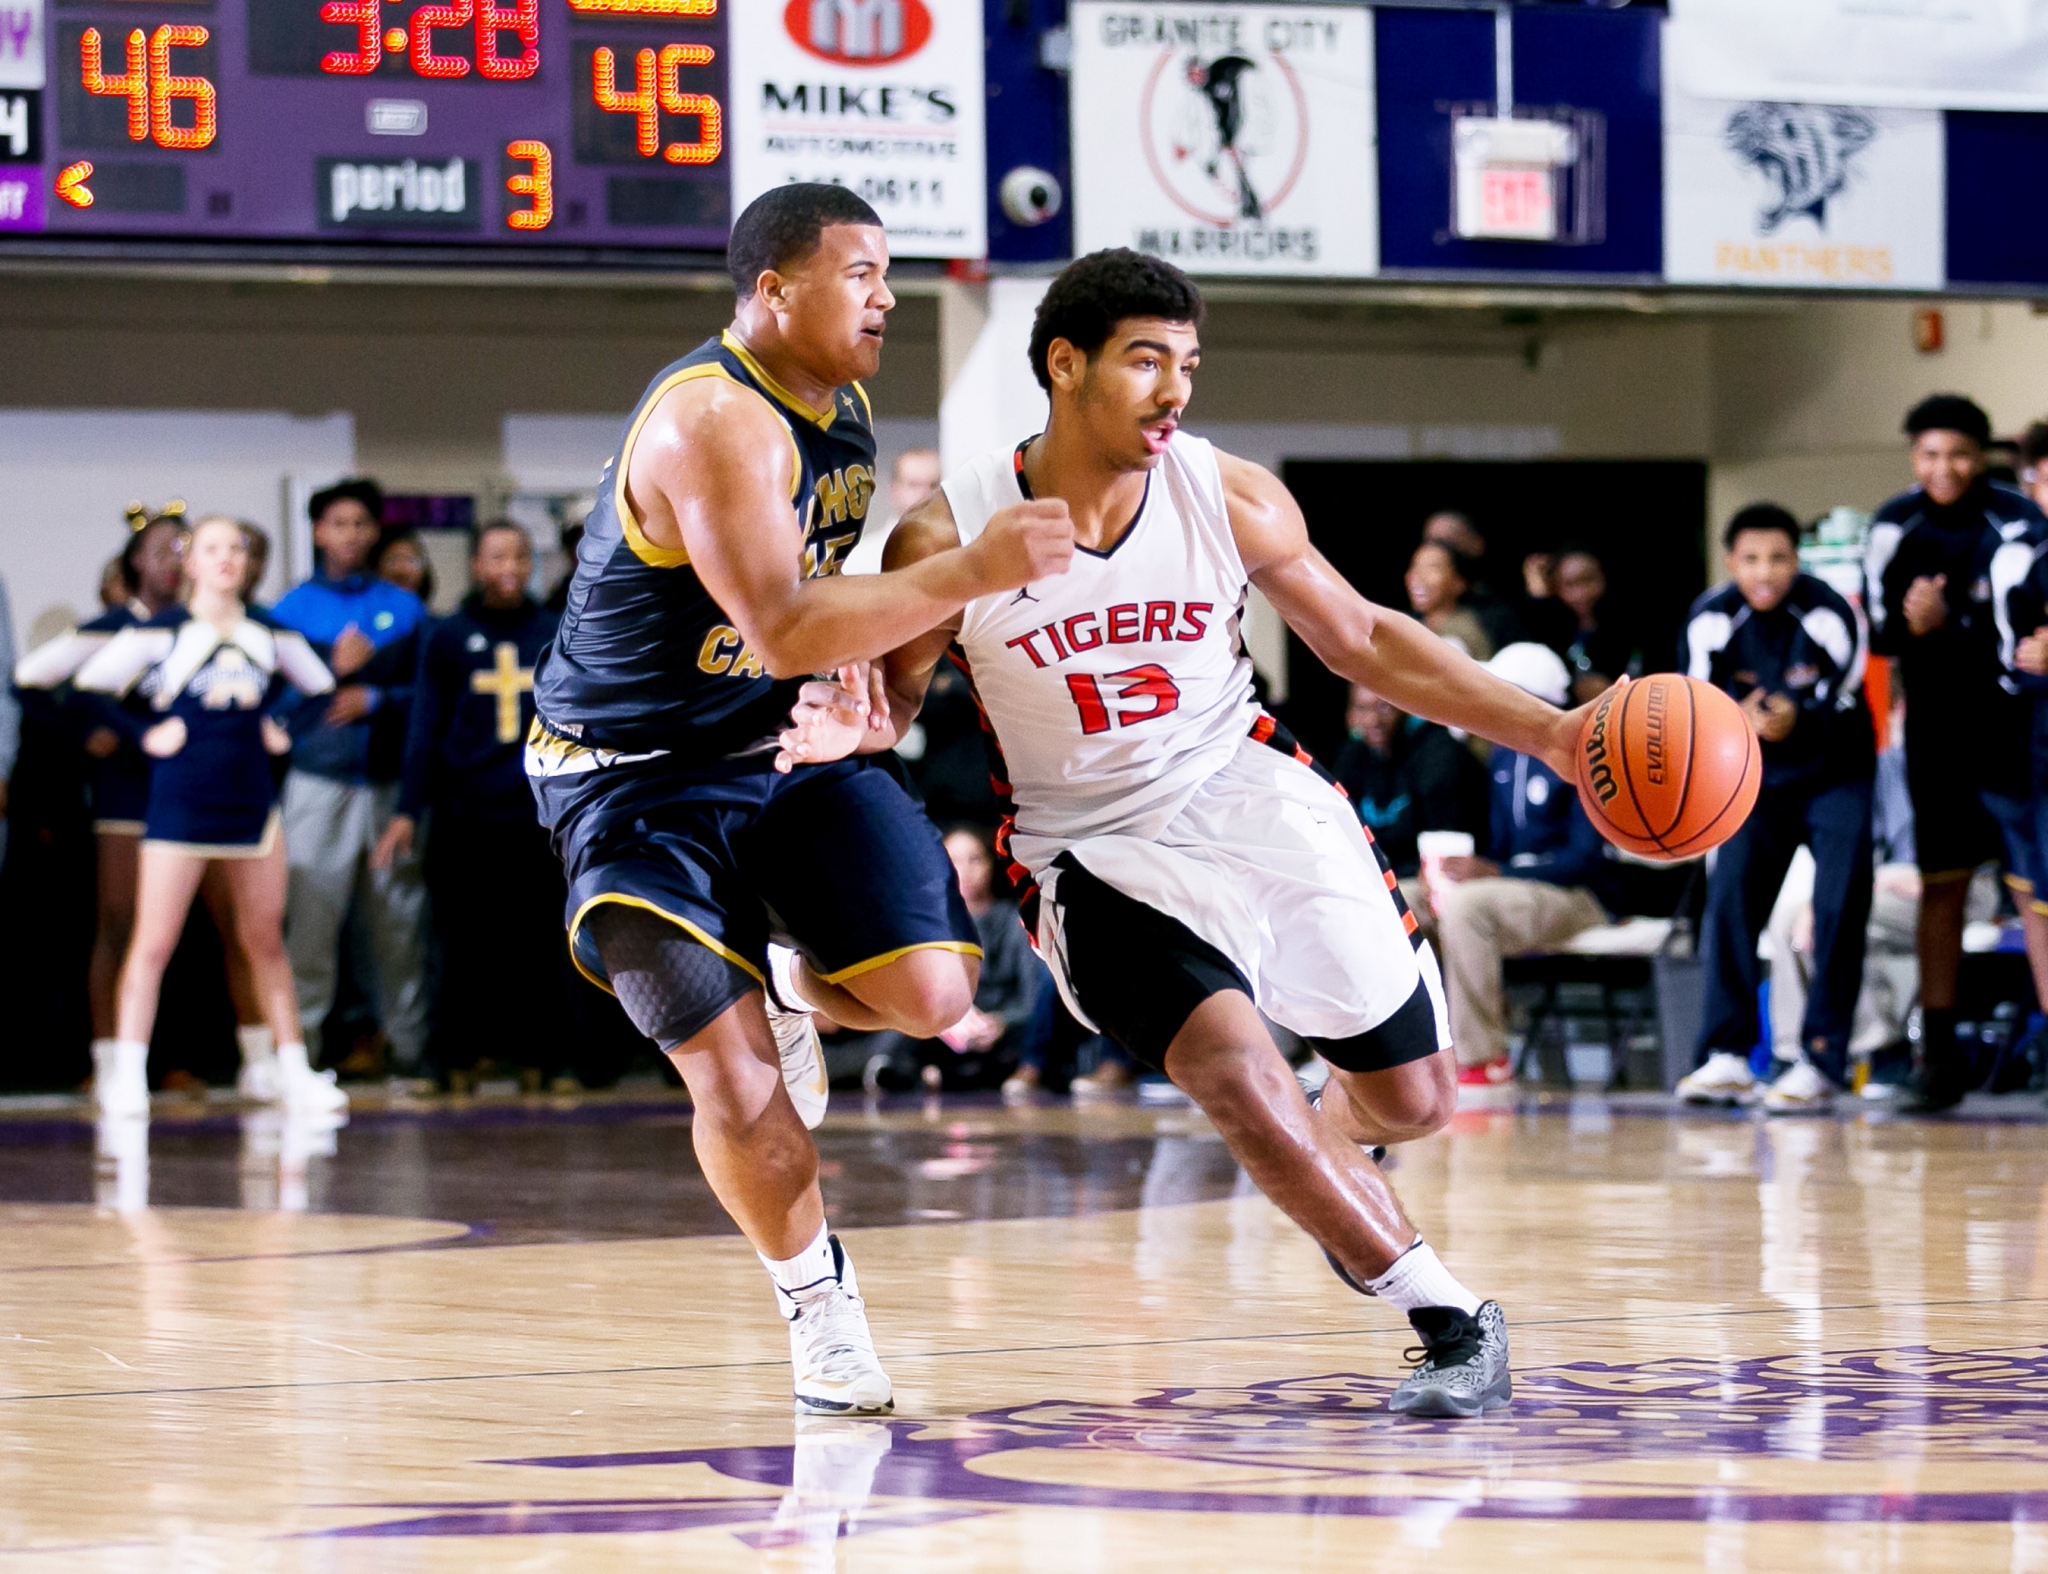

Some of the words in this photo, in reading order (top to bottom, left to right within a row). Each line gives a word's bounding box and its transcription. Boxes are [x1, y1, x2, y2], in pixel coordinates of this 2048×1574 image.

[1264, 18, 1339, 50] CITY
[80, 23, 216, 149] 46
[592, 43, 721, 164] 45
[762, 83, 957, 121] MIKE'S
[331, 155, 466, 222] period
[506, 140, 553, 231] 3
[1714, 241, 1895, 284] PANTHERS
[1005, 600, 1214, 669] TIGERS
[1064, 663, 1181, 735] 13
[1645, 682, 1665, 786] EVOLUTION
